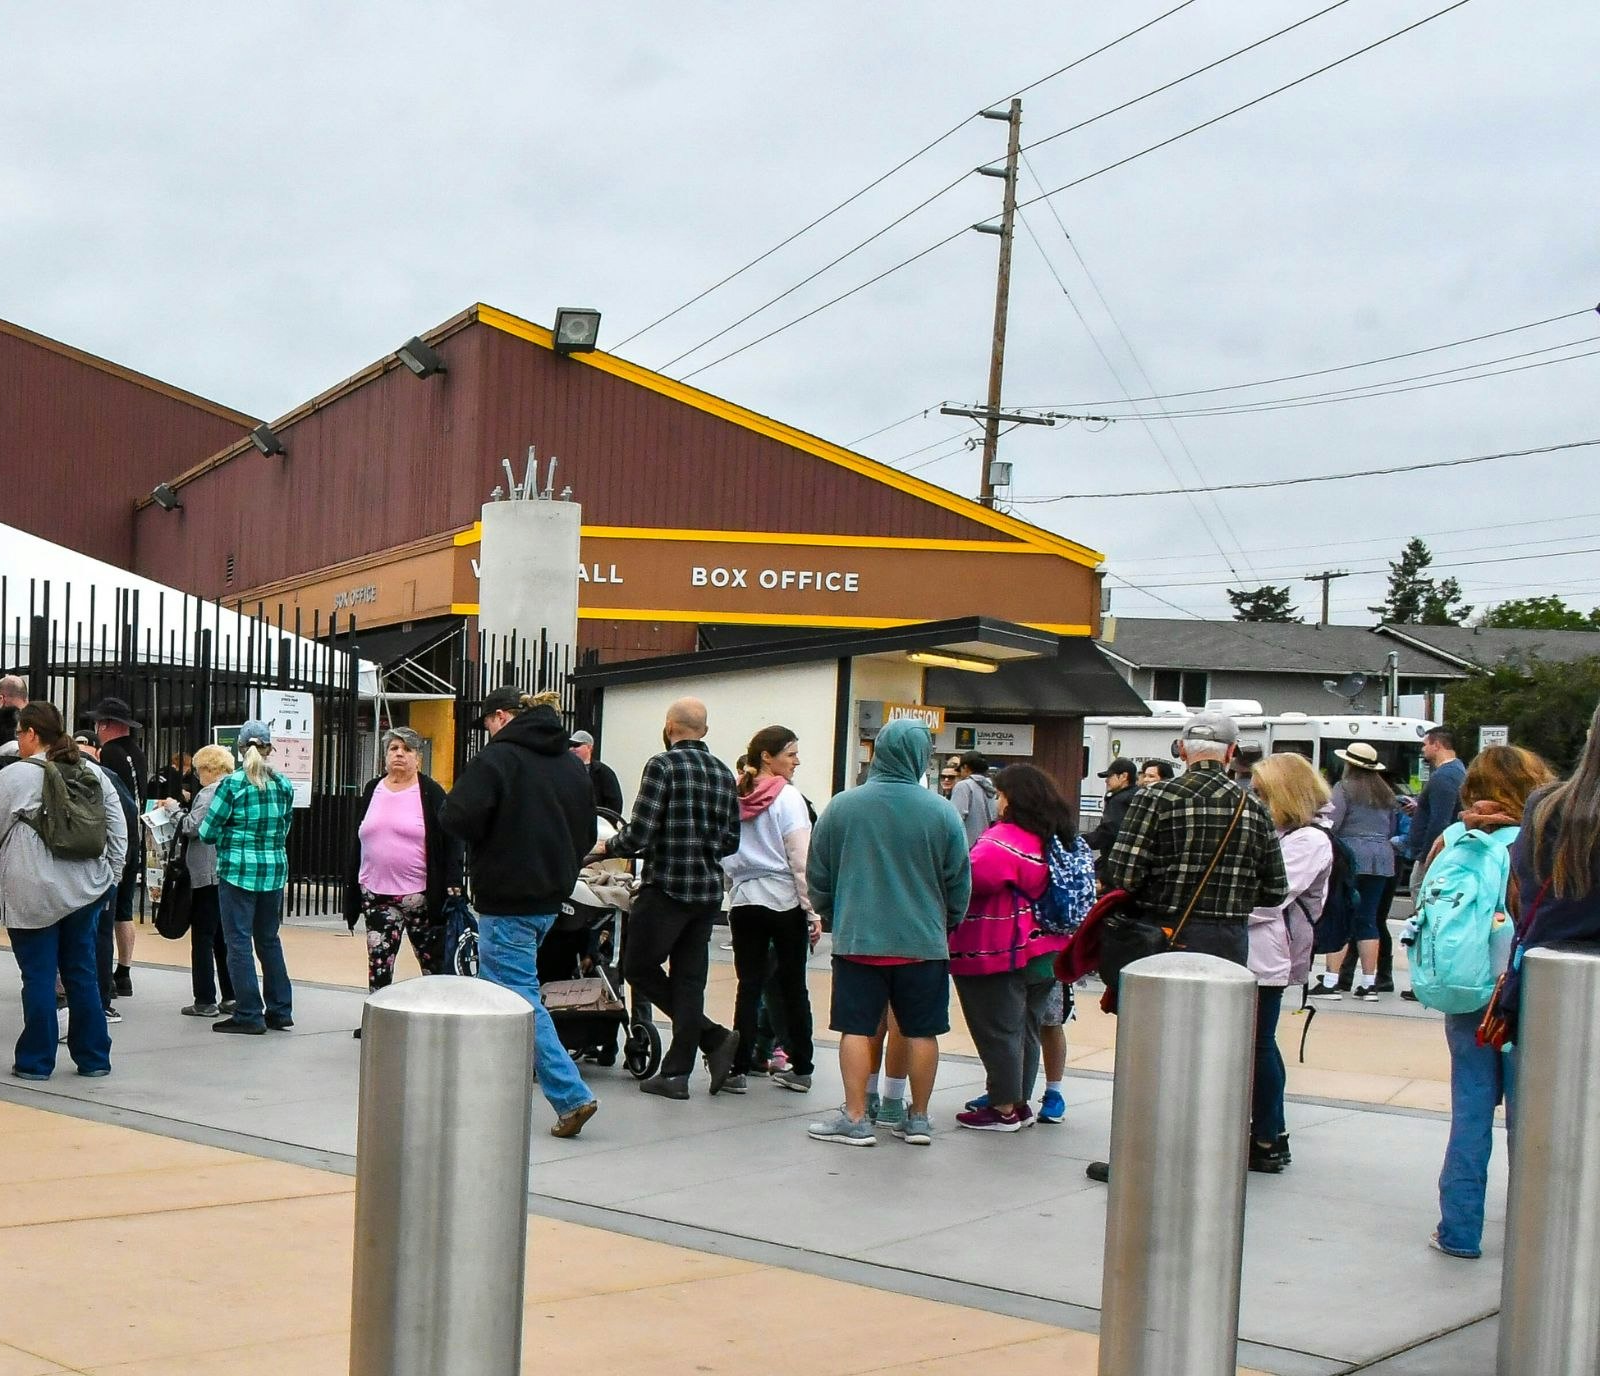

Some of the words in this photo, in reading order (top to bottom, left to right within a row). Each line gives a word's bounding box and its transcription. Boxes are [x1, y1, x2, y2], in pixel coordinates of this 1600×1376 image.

[691, 567, 748, 588] BOX
[759, 569, 859, 592] OFFICE
[350, 585, 377, 606] OFFICE
[977, 731, 1014, 739] UMPQUA
